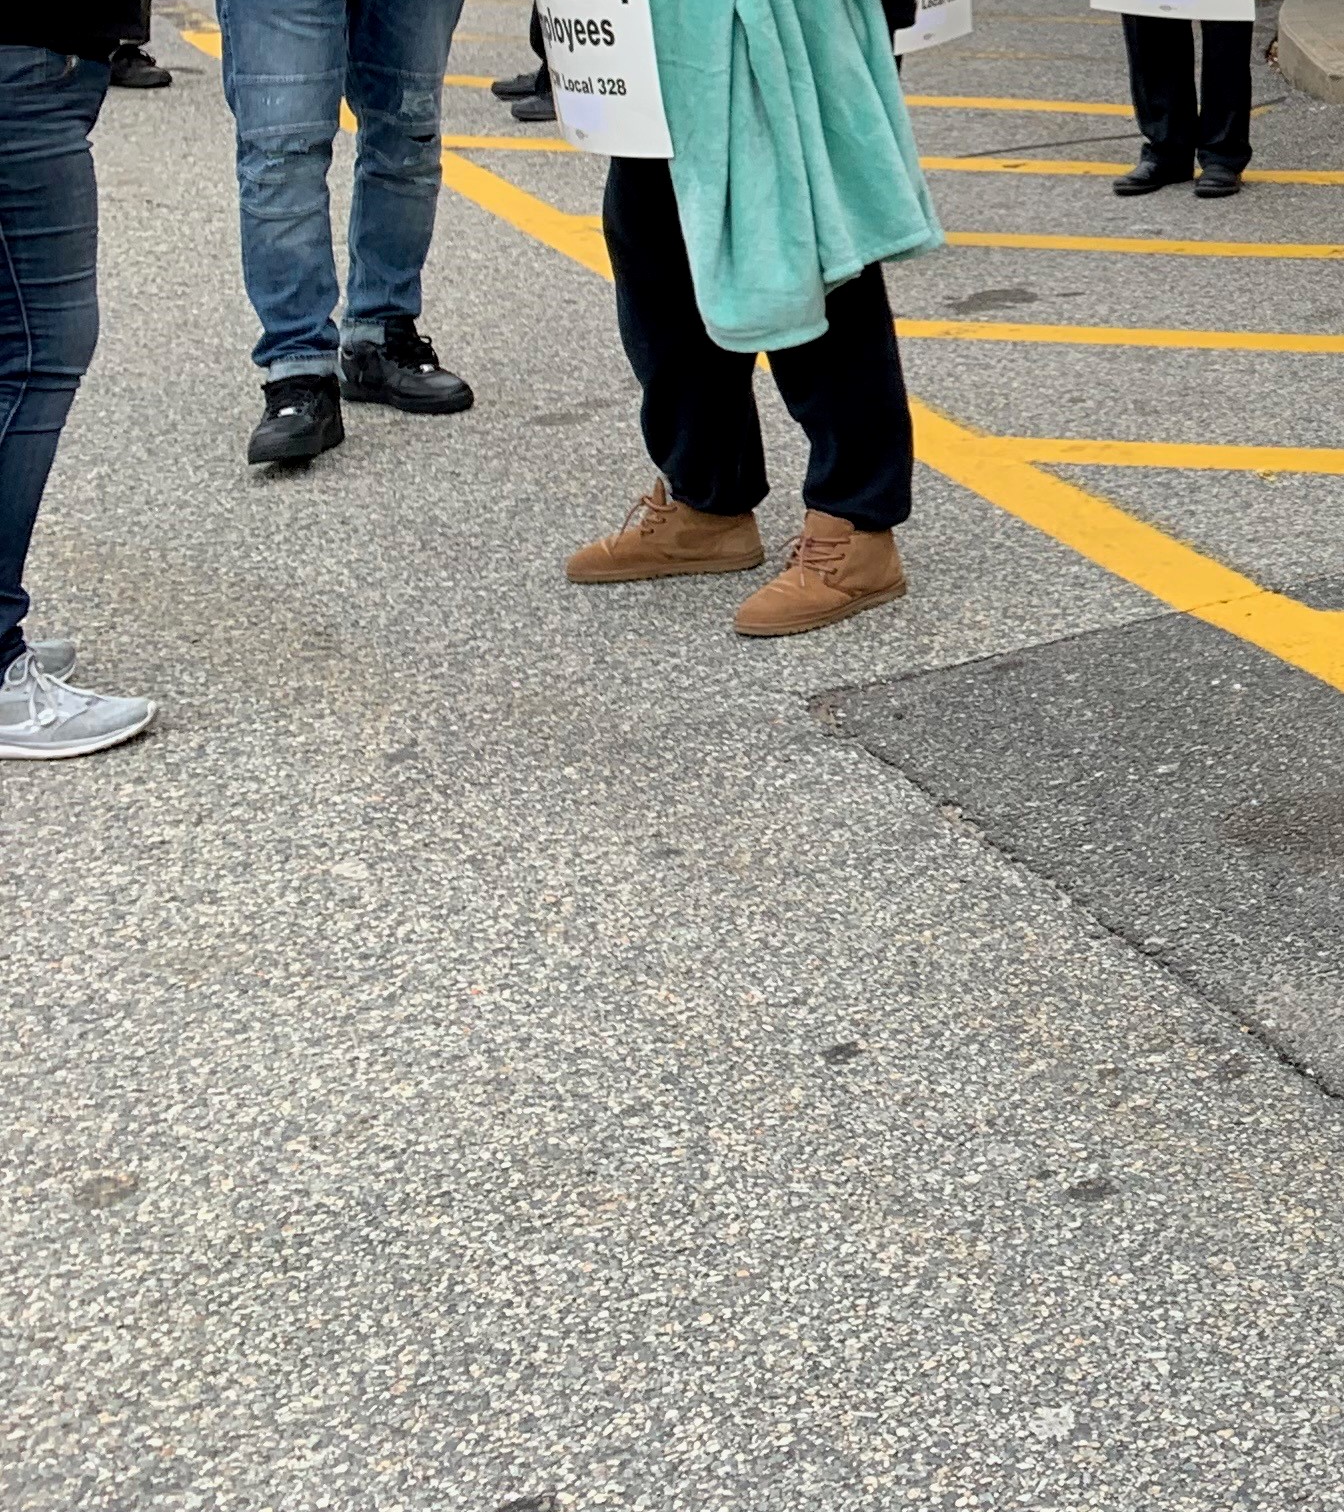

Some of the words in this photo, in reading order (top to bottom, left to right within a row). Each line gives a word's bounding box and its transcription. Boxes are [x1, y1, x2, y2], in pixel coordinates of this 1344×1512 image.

[540, 6, 615, 52] ployees
[562, 73, 594, 94] Local
[597, 77, 627, 96] 328
